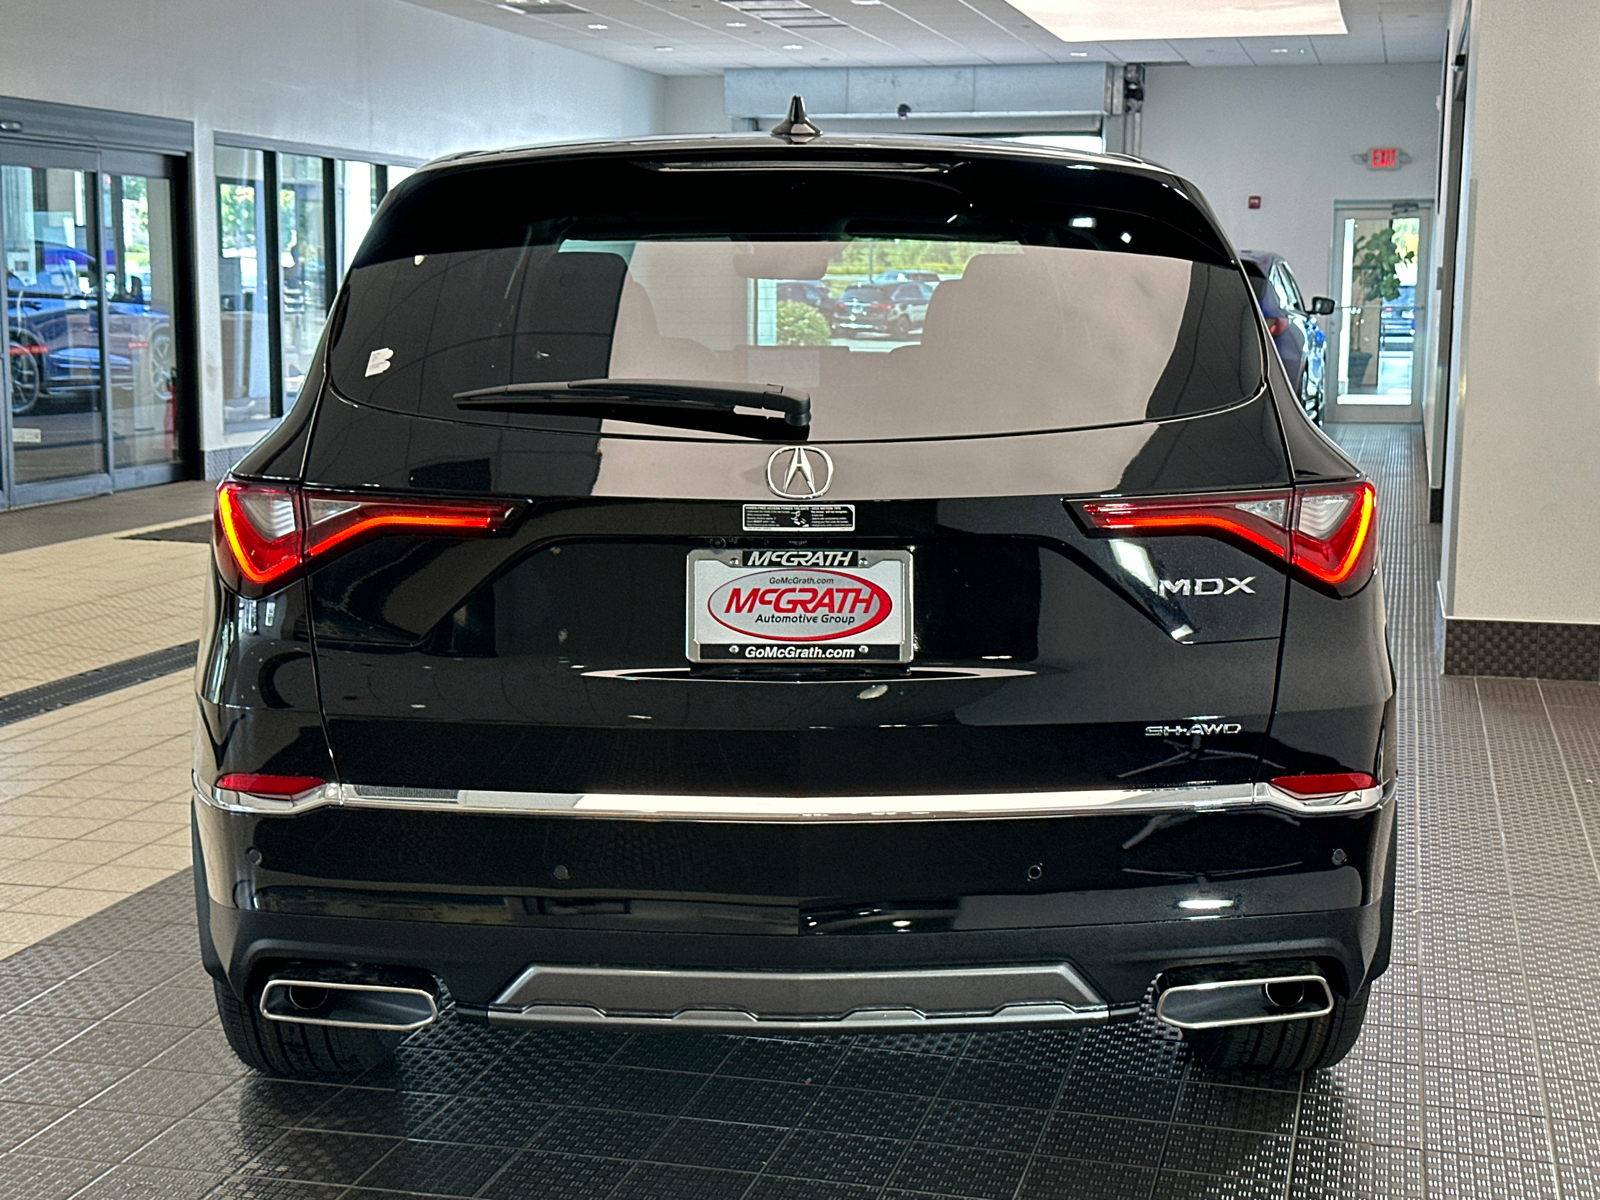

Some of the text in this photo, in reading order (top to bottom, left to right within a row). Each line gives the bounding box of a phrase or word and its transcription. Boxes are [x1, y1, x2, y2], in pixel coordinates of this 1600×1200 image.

[1372, 148, 1396, 167] EXIT
[769, 577, 834, 585] GoMcGrath.com
[1158, 576, 1256, 597] MDX
[755, 614, 856, 625] Automotive Group
[745, 646, 855, 658] GoMcGrath.com
[1145, 723, 1242, 736] SH-AWD
